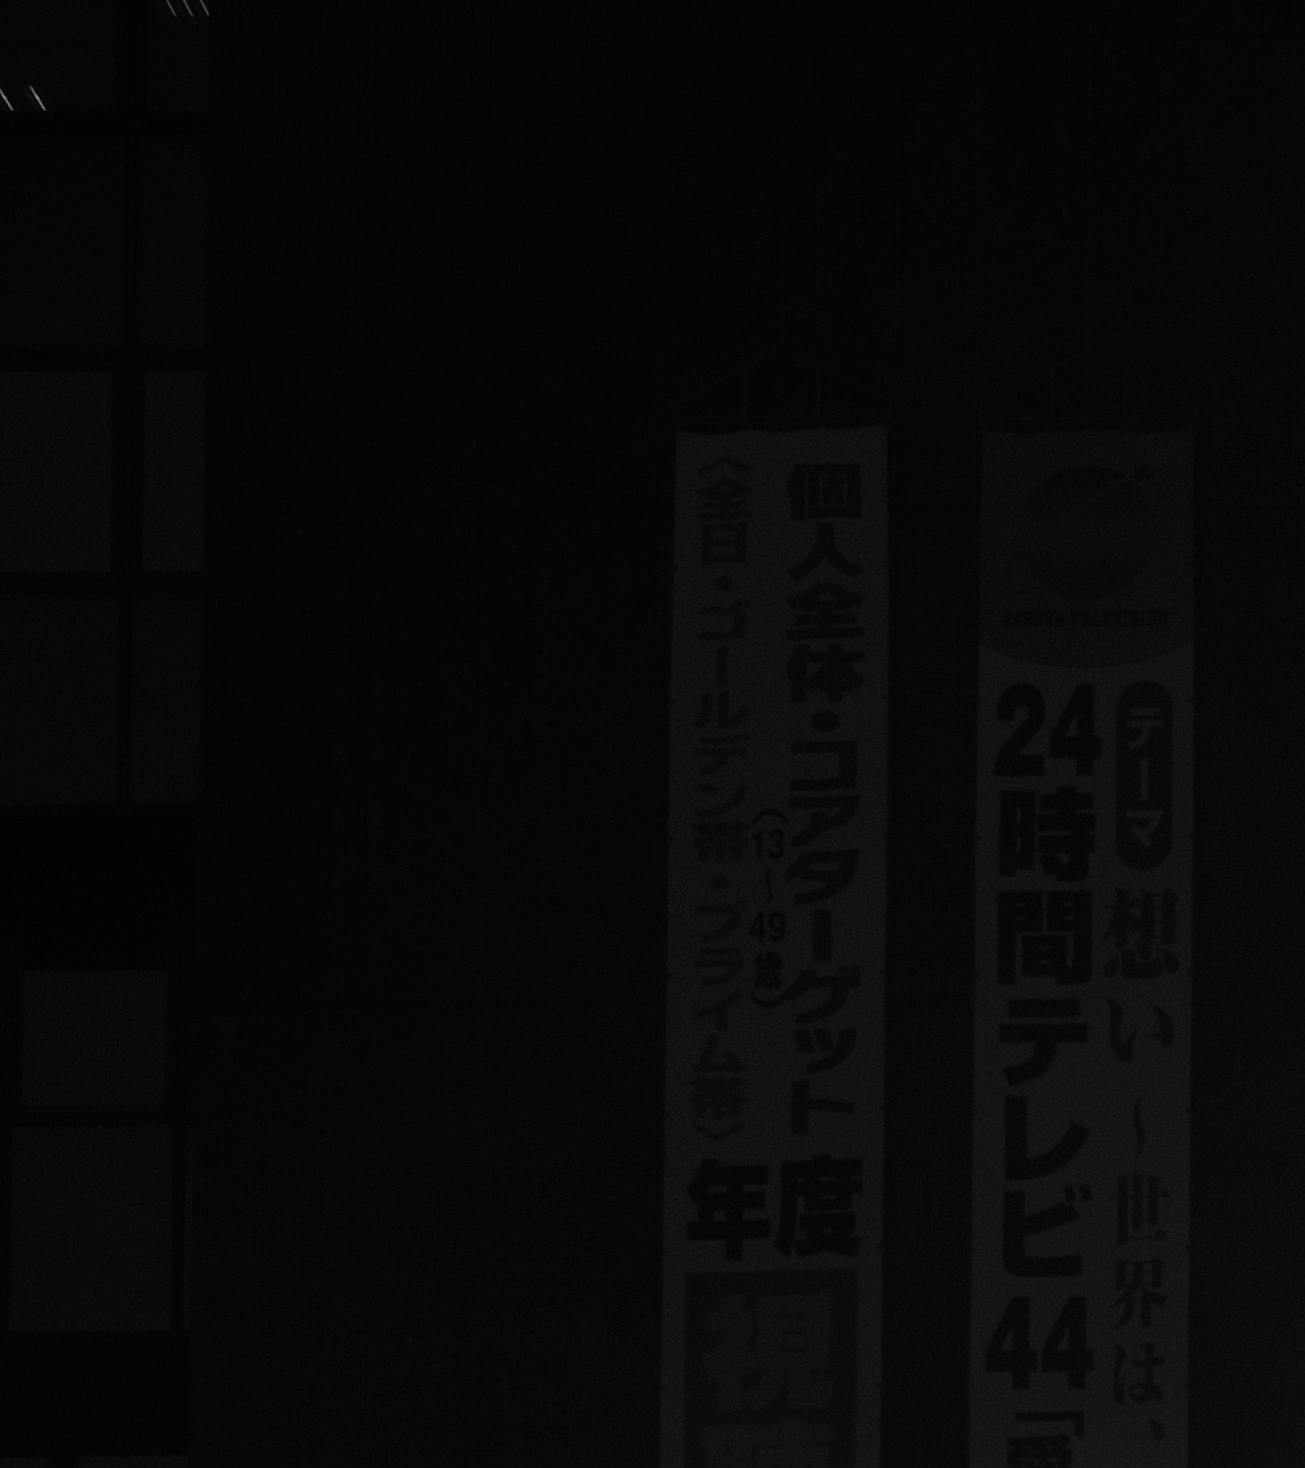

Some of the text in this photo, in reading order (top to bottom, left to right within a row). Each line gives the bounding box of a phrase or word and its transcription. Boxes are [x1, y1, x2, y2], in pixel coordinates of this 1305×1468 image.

[1125, 707, 1164, 848] テーマ
[687, 1154, 863, 1261] 年度
